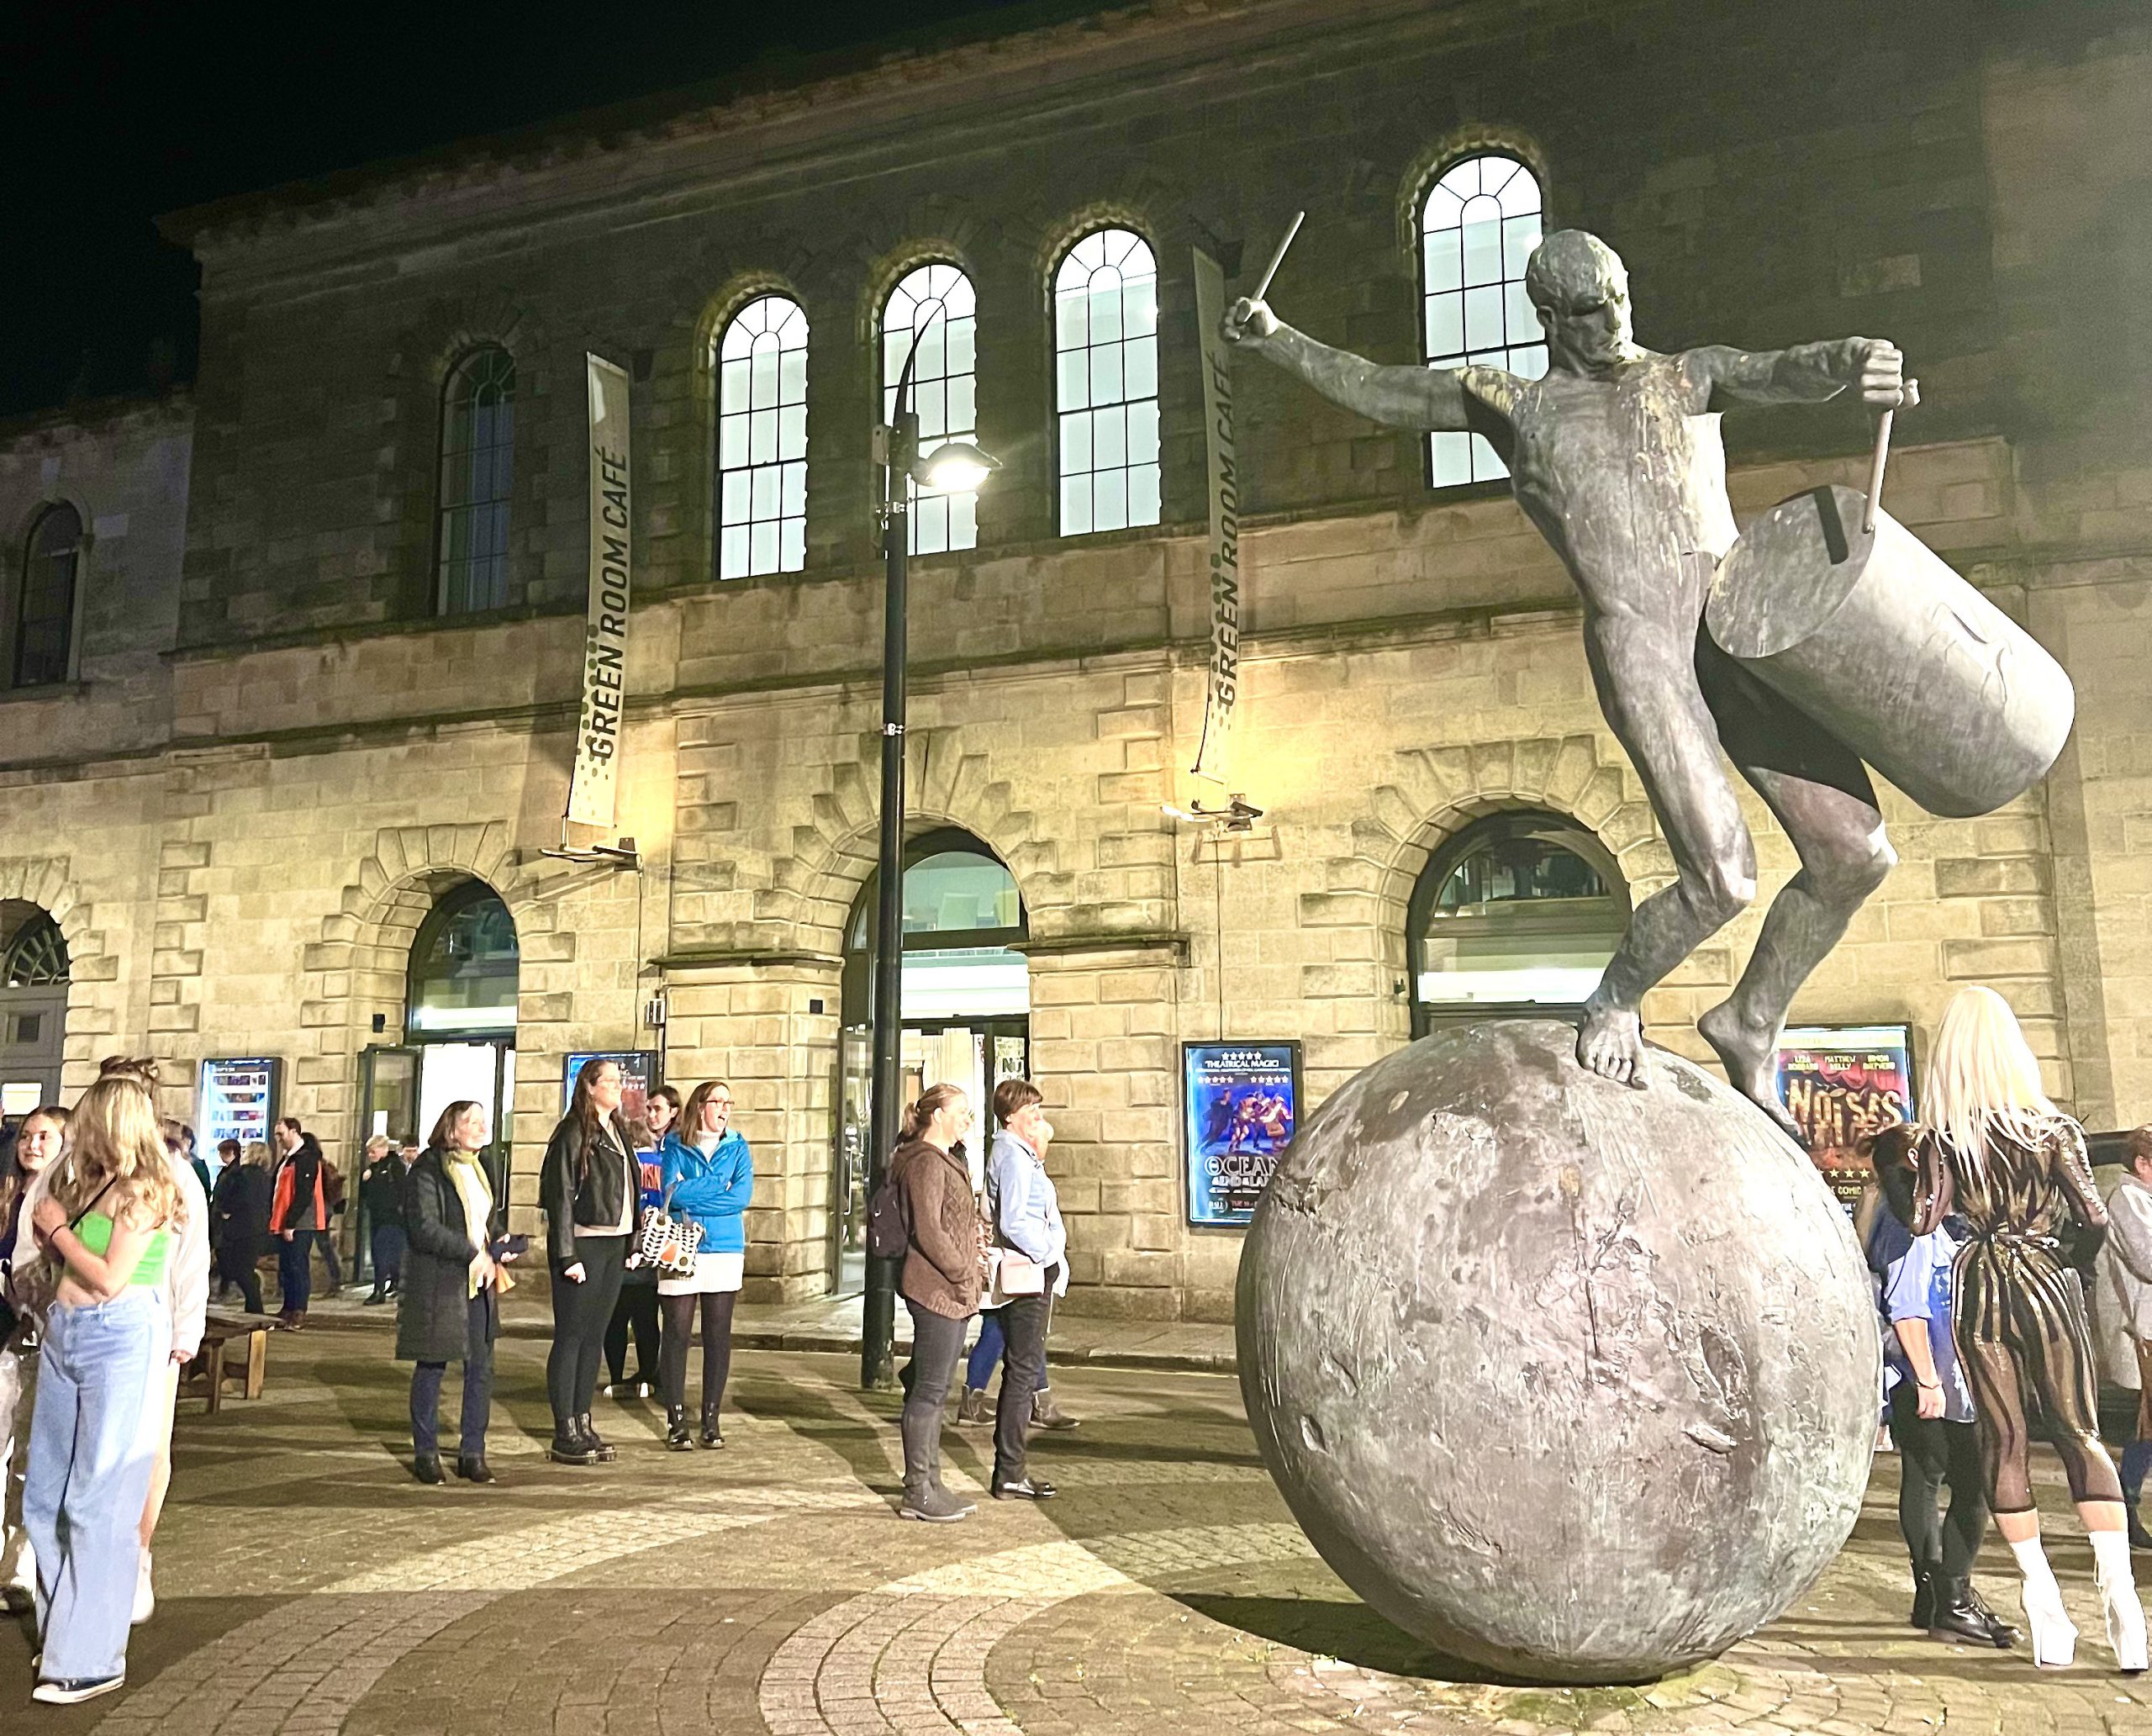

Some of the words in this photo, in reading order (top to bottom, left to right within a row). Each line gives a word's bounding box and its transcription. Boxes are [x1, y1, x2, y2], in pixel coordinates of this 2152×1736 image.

[593, 445, 627, 529] CAFÉ
[1220, 451, 1238, 570] ROOM
[599, 535, 628, 638] ROOM
[1218, 577, 1238, 707] GREEN
[589, 644, 624, 759] GREEN
[1838, 1185, 1862, 1195] COMIC
